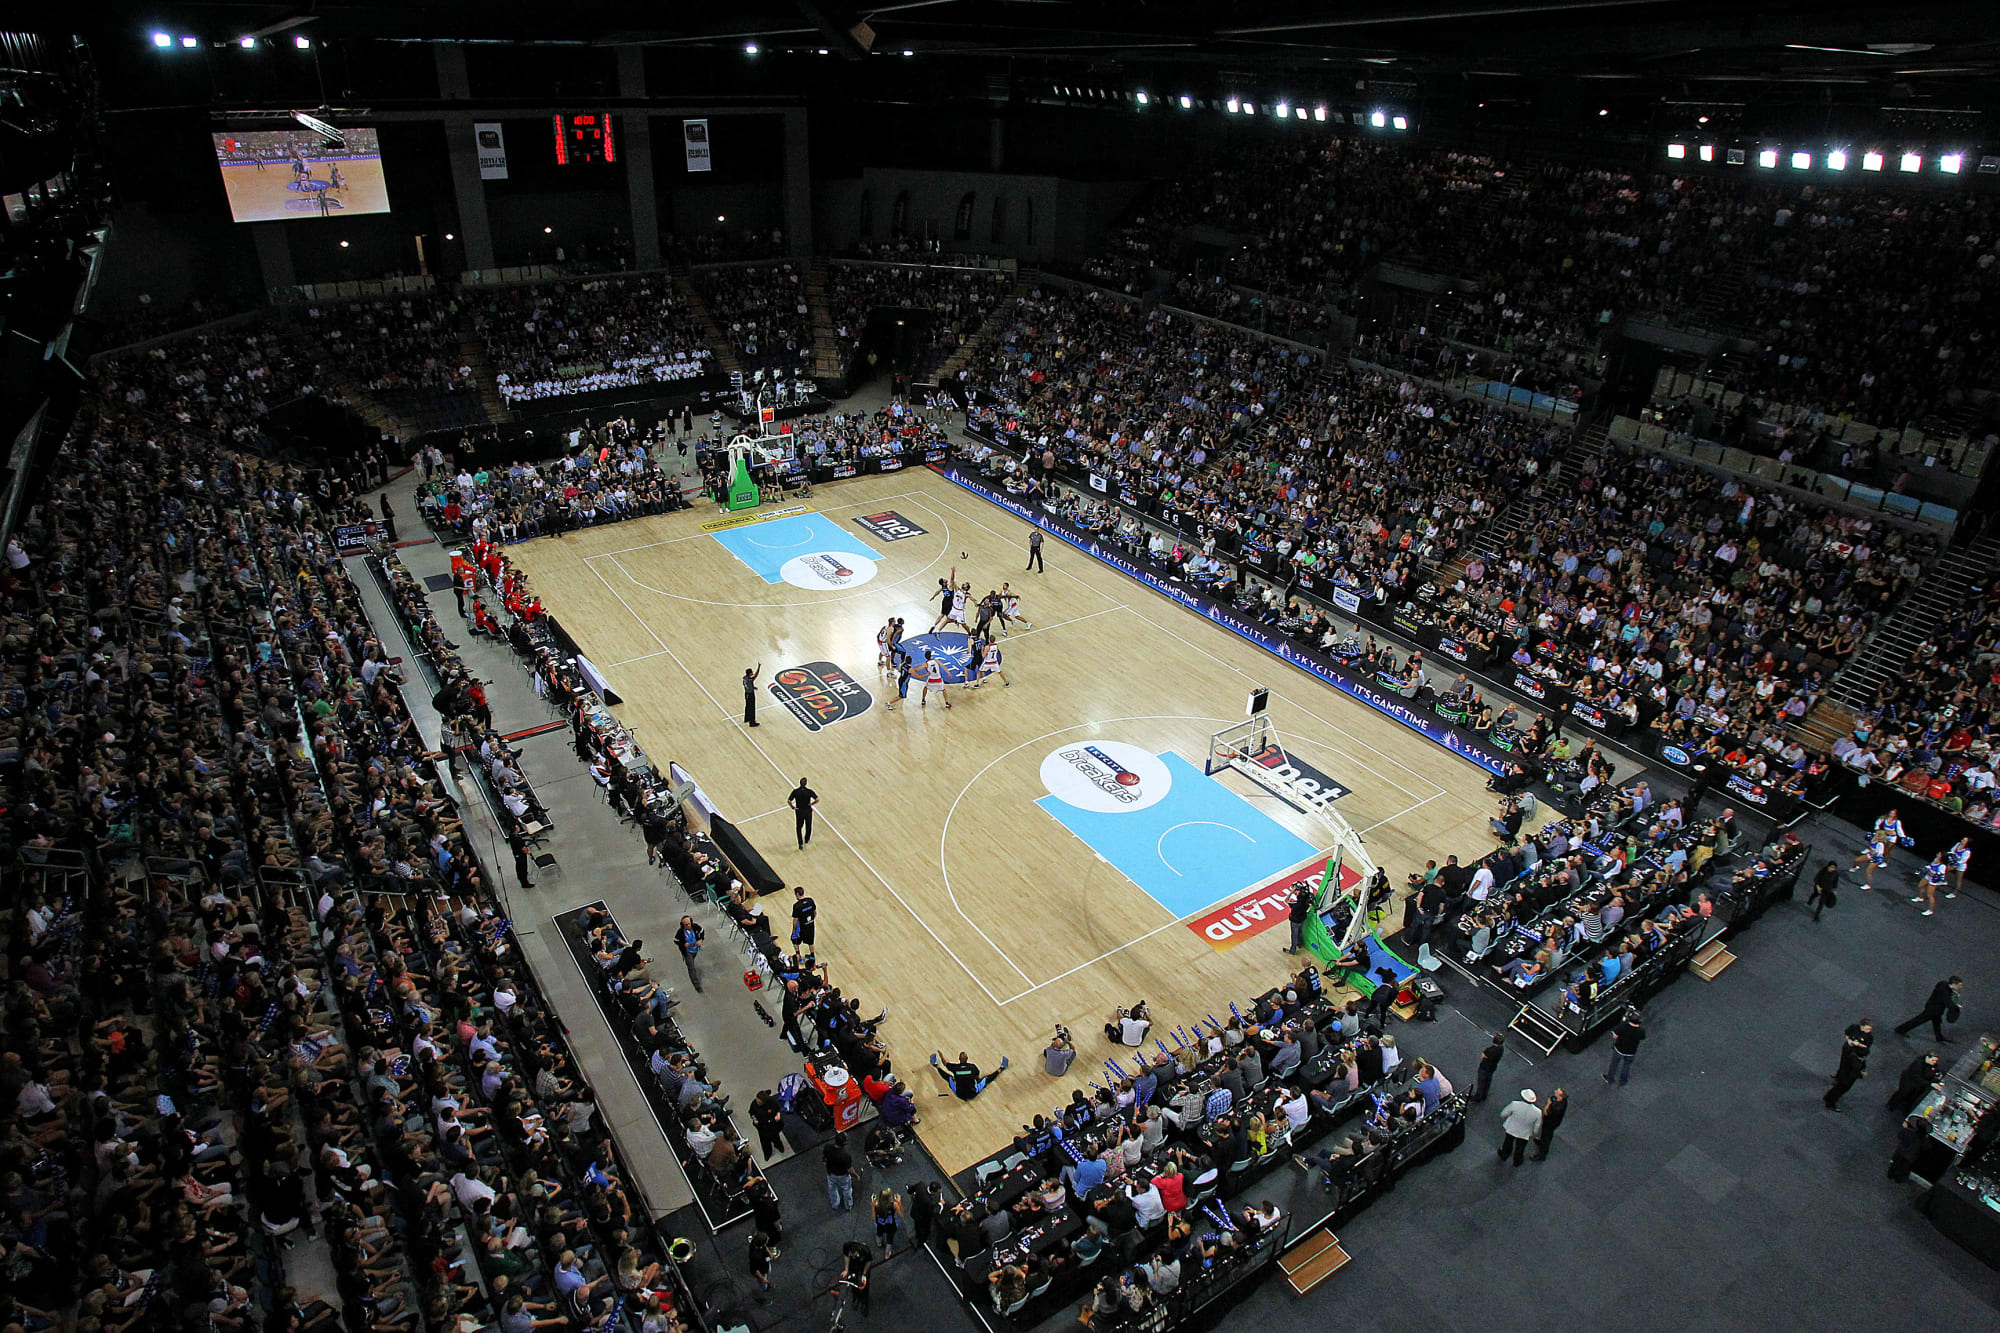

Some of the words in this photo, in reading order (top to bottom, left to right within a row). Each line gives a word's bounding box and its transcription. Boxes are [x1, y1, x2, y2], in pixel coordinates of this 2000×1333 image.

[960, 476, 988, 495] SKYCITY
[1002, 497, 1020, 511] GAME
[1019, 505, 1033, 518] TIME
[1051, 523, 1083, 545] SKYCITY
[1102, 550, 1139, 574] SKYCITY
[1144, 571, 1158, 585] IT'S
[1158, 580, 1180, 597] GAME
[1180, 590, 1199, 607] TIME
[1223, 615, 1269, 642] SKYCITY
[1294, 653, 1345, 683] SKYCITY
[1353, 683, 1372, 700] IT'S
[1372, 694, 1404, 716] GAME
[1403, 709, 1430, 731] TIME
[1059, 749, 1139, 804] breakers
[842, 1102, 858, 1120] G
